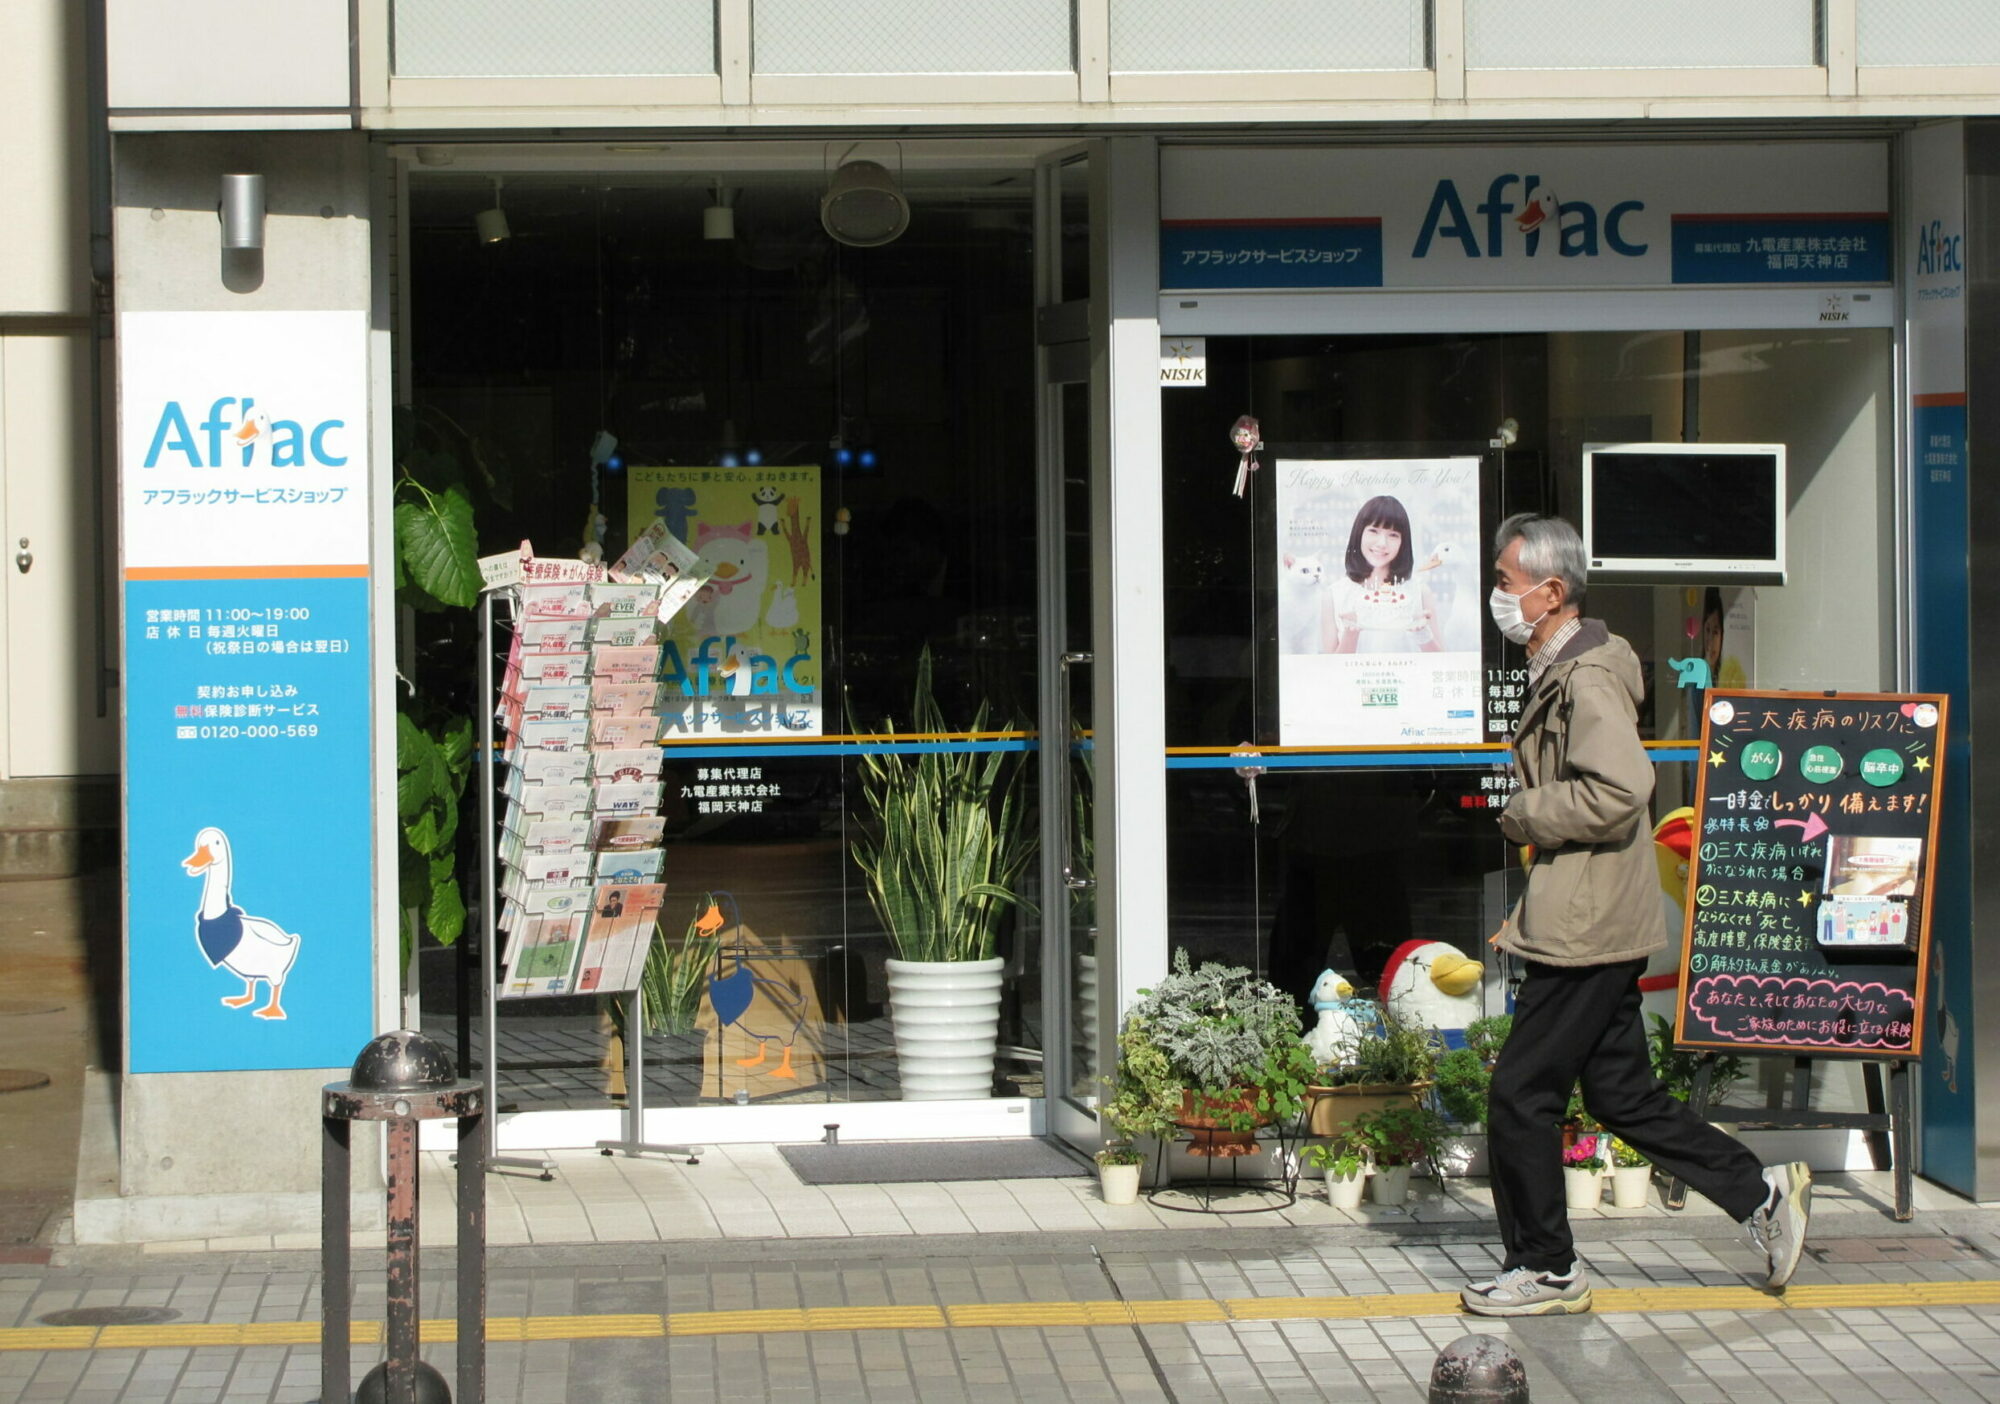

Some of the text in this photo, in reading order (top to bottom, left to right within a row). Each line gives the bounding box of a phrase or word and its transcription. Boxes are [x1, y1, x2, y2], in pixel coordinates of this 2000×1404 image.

[1411, 174, 1648, 258] Aflac
[1745, 236, 1867, 253] 九電産業株式会社
[1917, 220, 1961, 275] Aflac
[1181, 247, 1363, 266] アフラックサービスショップ
[1767, 253, 1849, 271] 福岡天神店
[143, 397, 348, 468] Aflac
[1285, 468, 1334, 489] Happy
[1341, 470, 1401, 489] Birthday
[143, 487, 348, 505] アフラックサービスショップ
[145, 609, 201, 623] 営業時間
[207, 624, 279, 638] 毎週火曜日
[657, 636, 816, 697] Aflac
[197, 685, 298, 700] 契約お申し込み
[1369, 693, 1398, 703] EVER
[200, 725, 318, 739] 0120-000-569
[1750, 751, 1775, 765] がん
[697, 767, 762, 780] 募集代理店
[1863, 761, 1900, 775] 脳卒中
[680, 784, 781, 798] 九電産業株式会社
[613, 800, 640, 809] WAYS
[698, 800, 763, 814] 福岡天神店
